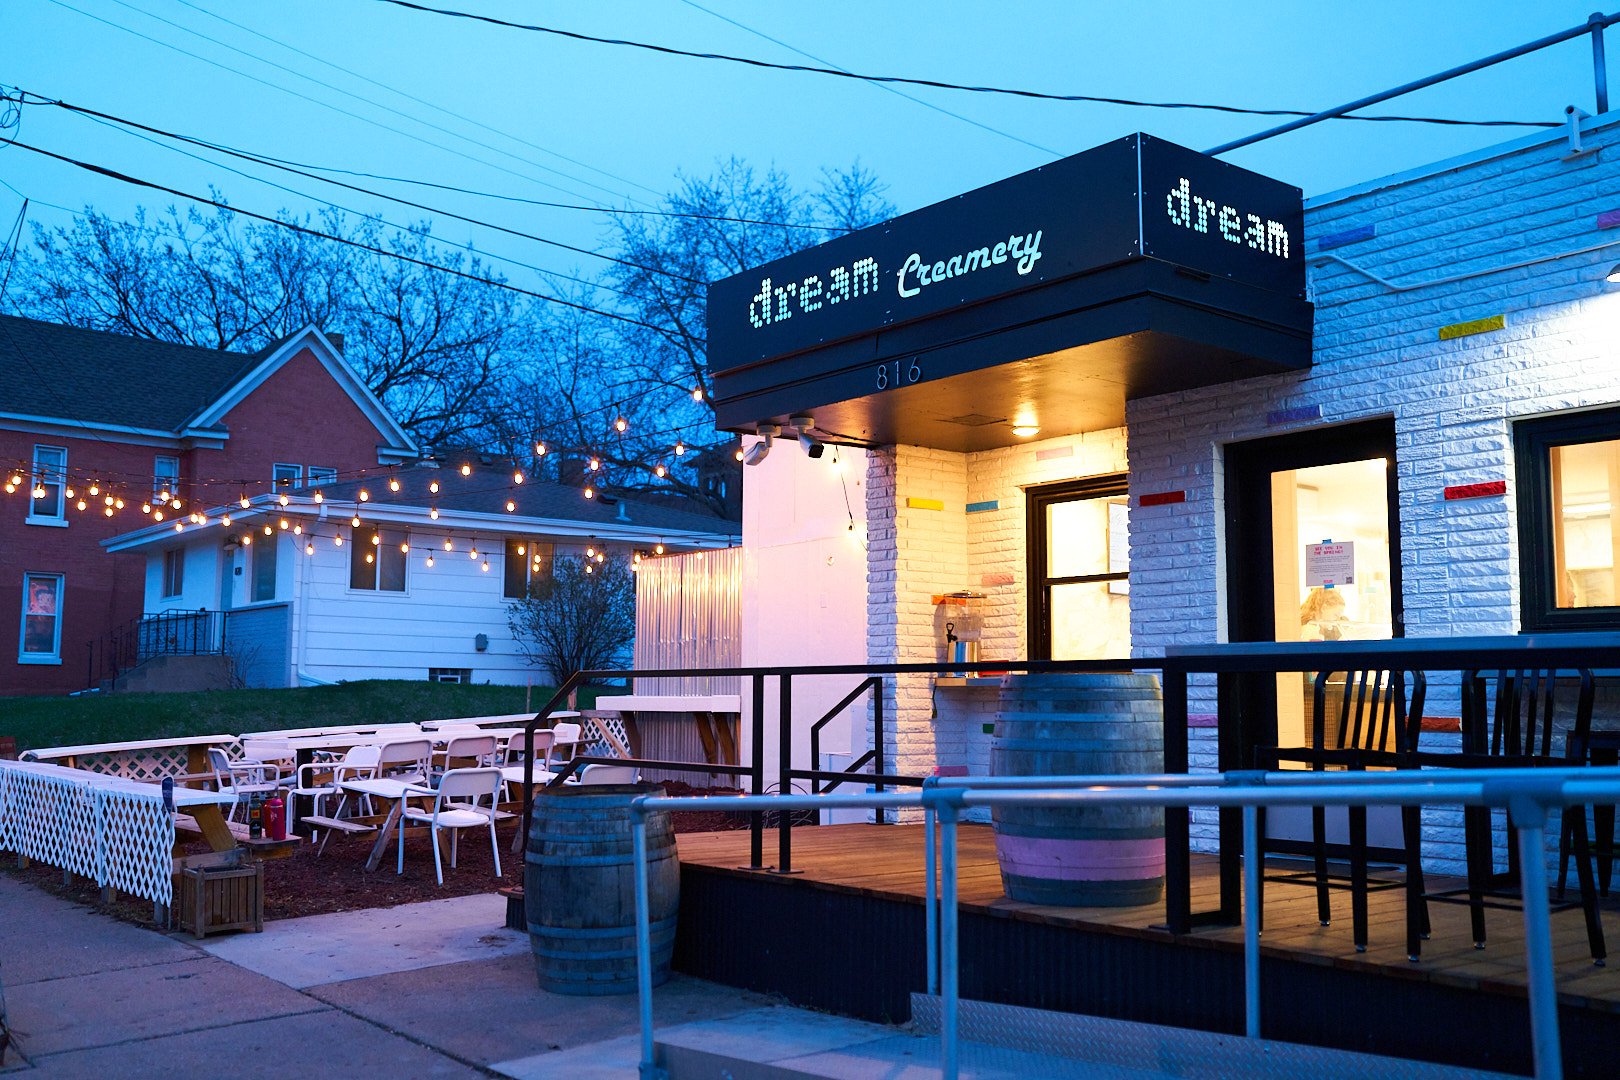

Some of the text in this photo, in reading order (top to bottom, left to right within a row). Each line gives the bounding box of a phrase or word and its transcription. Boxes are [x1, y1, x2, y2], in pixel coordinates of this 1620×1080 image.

[1167, 178, 1289, 259] dream
[750, 230, 1042, 328] dream Creamery
[877, 357, 921, 390] 816
